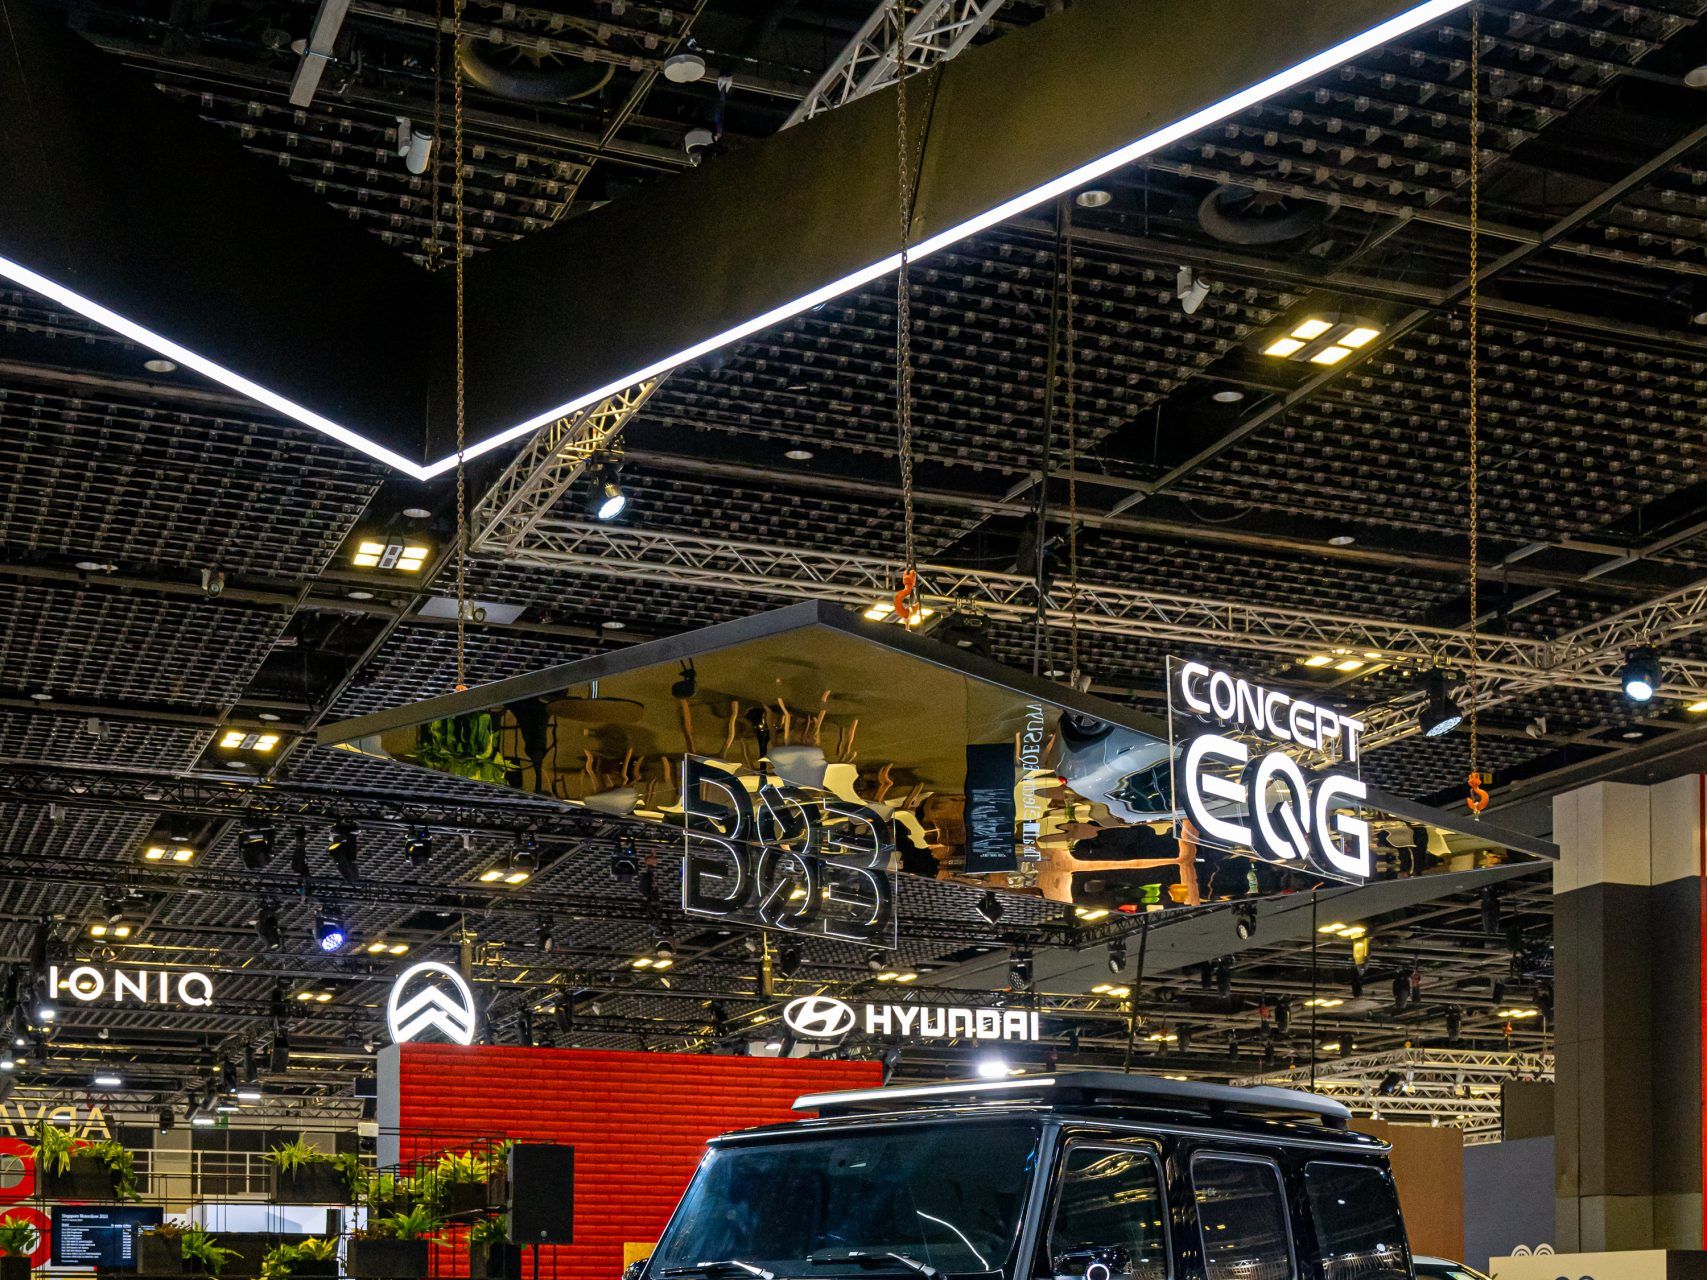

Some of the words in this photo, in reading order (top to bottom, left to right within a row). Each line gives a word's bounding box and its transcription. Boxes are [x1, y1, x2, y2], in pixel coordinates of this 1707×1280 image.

[1181, 661, 1364, 762] CONCEPT
[1184, 733, 1370, 878] EQG
[50, 965, 214, 1007] IONIQ
[865, 1004, 1040, 1041] HYUNDAI
